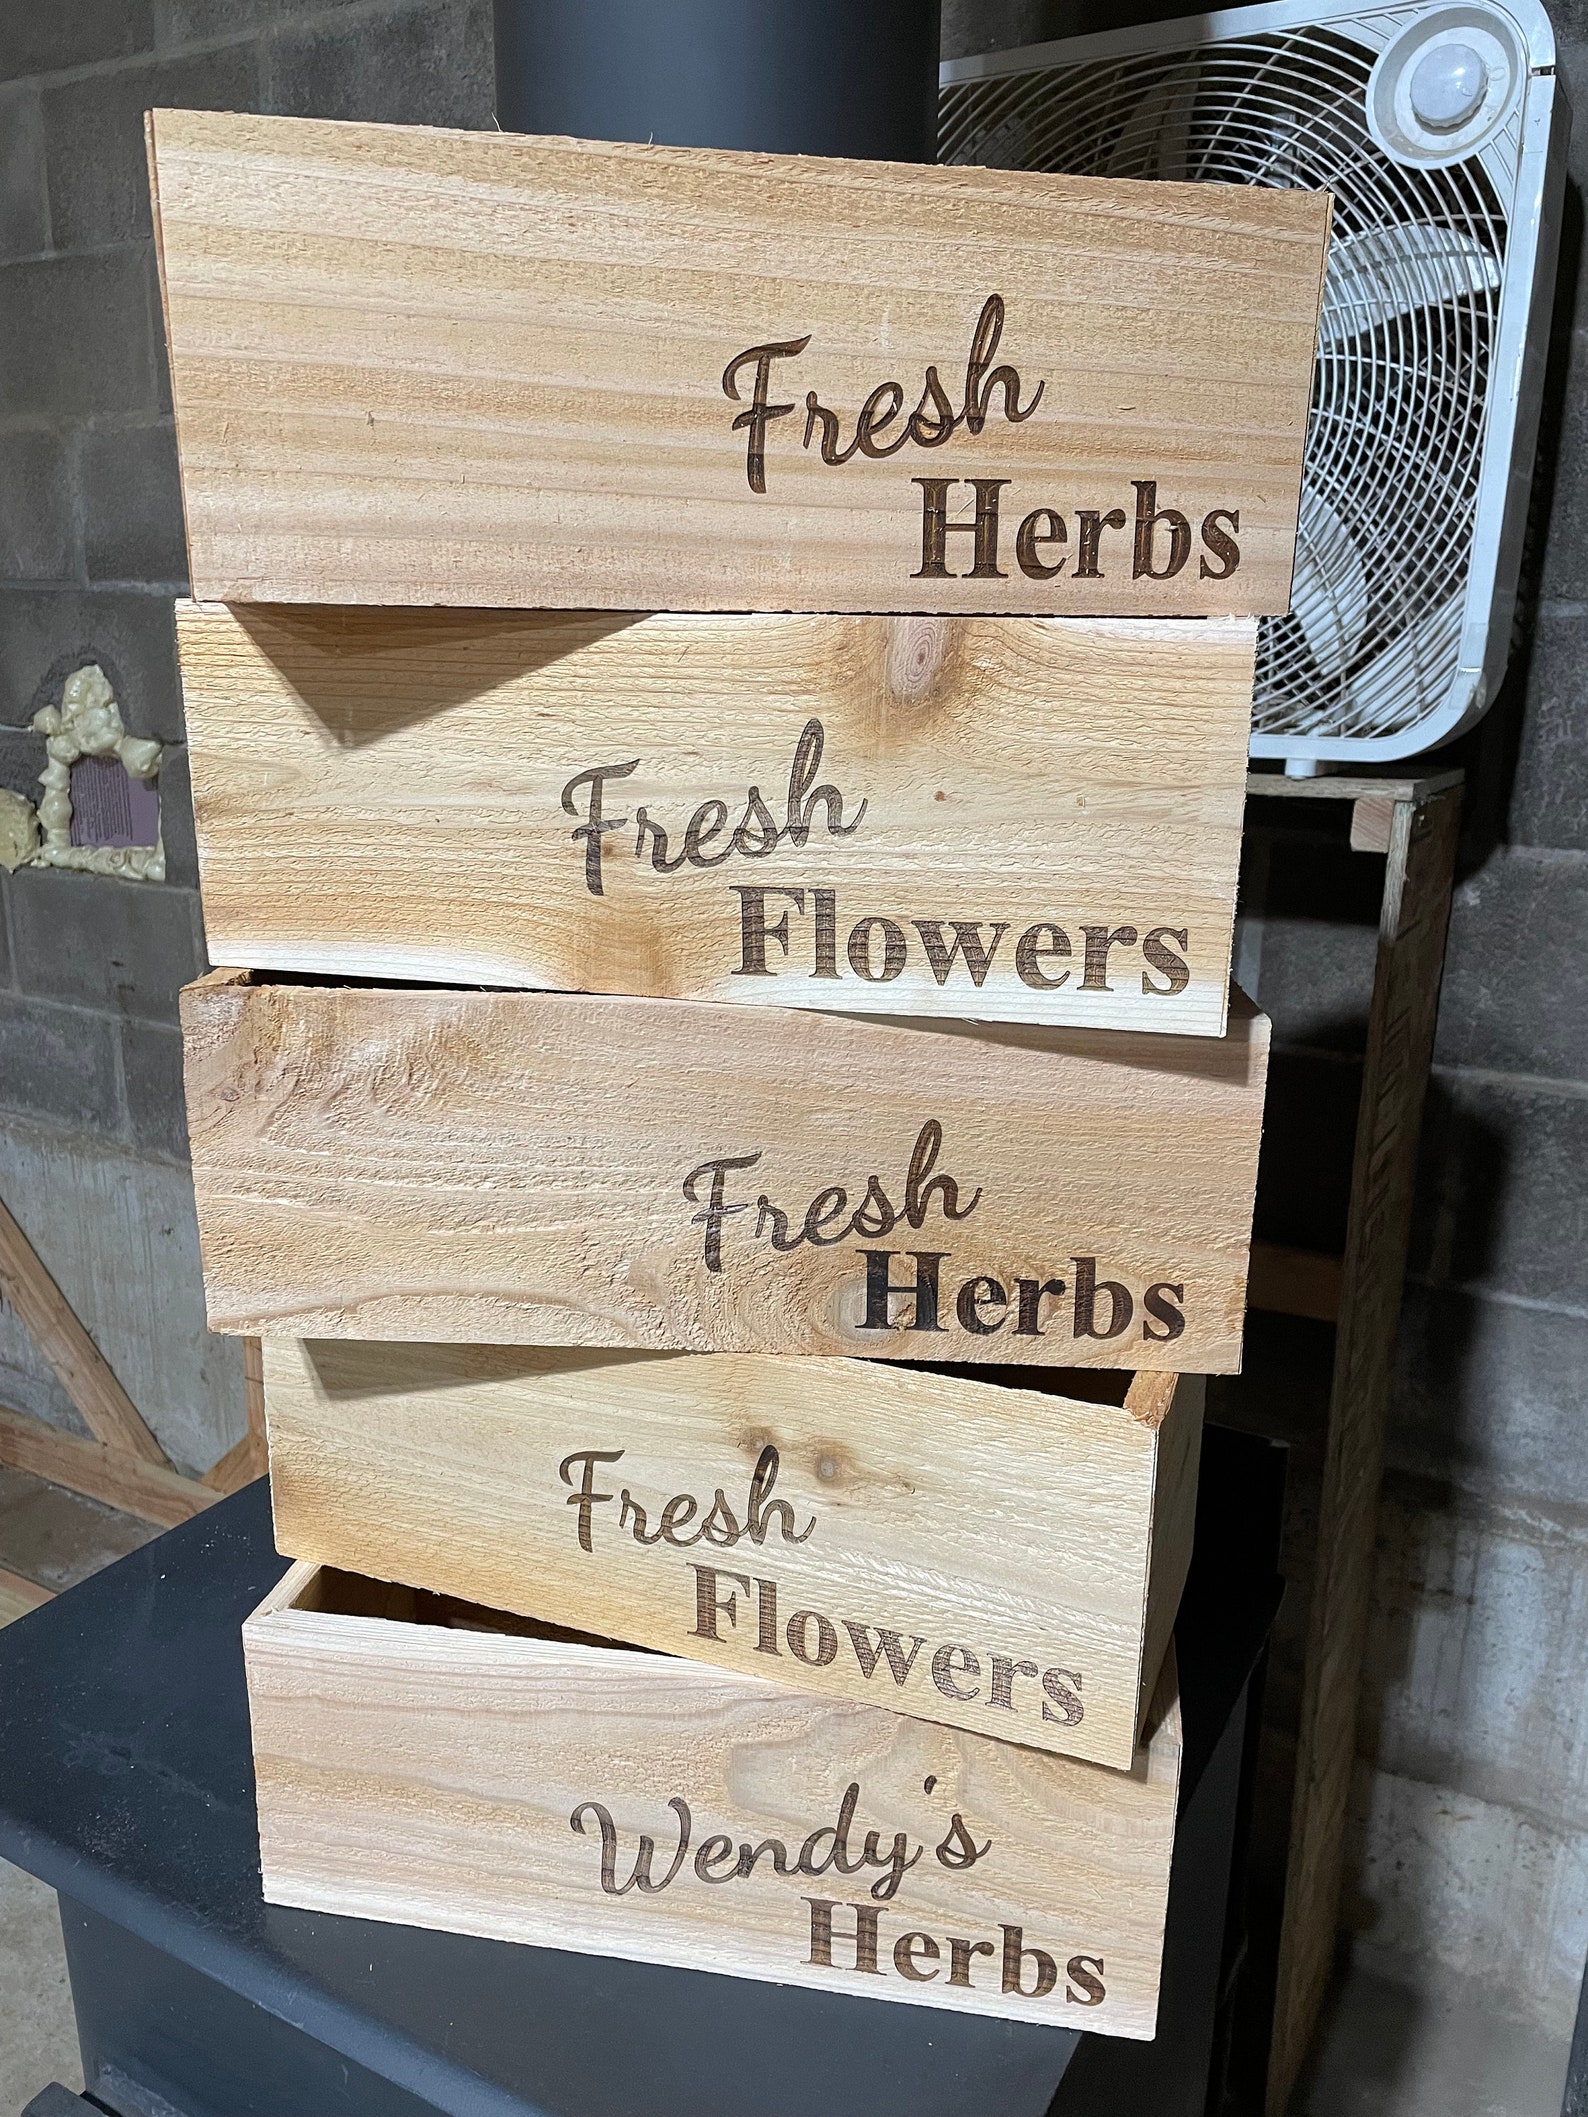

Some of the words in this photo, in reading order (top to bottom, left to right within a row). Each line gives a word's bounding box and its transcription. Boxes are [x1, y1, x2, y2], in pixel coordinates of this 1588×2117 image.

[722, 293, 1045, 493] Fresh
[910, 477, 1241, 580] Herbs
[561, 718, 868, 894] Fresh
[729, 885, 1190, 995] Flowers
[682, 1119, 983, 1273] Fresh
[854, 1249, 1185, 1341] Herbs
[559, 1445, 817, 1553] Fresh
[686, 1562, 1084, 1726] Flowers
[570, 1774, 991, 1901] Wendy's
[799, 1896, 1106, 2006] Herbs
